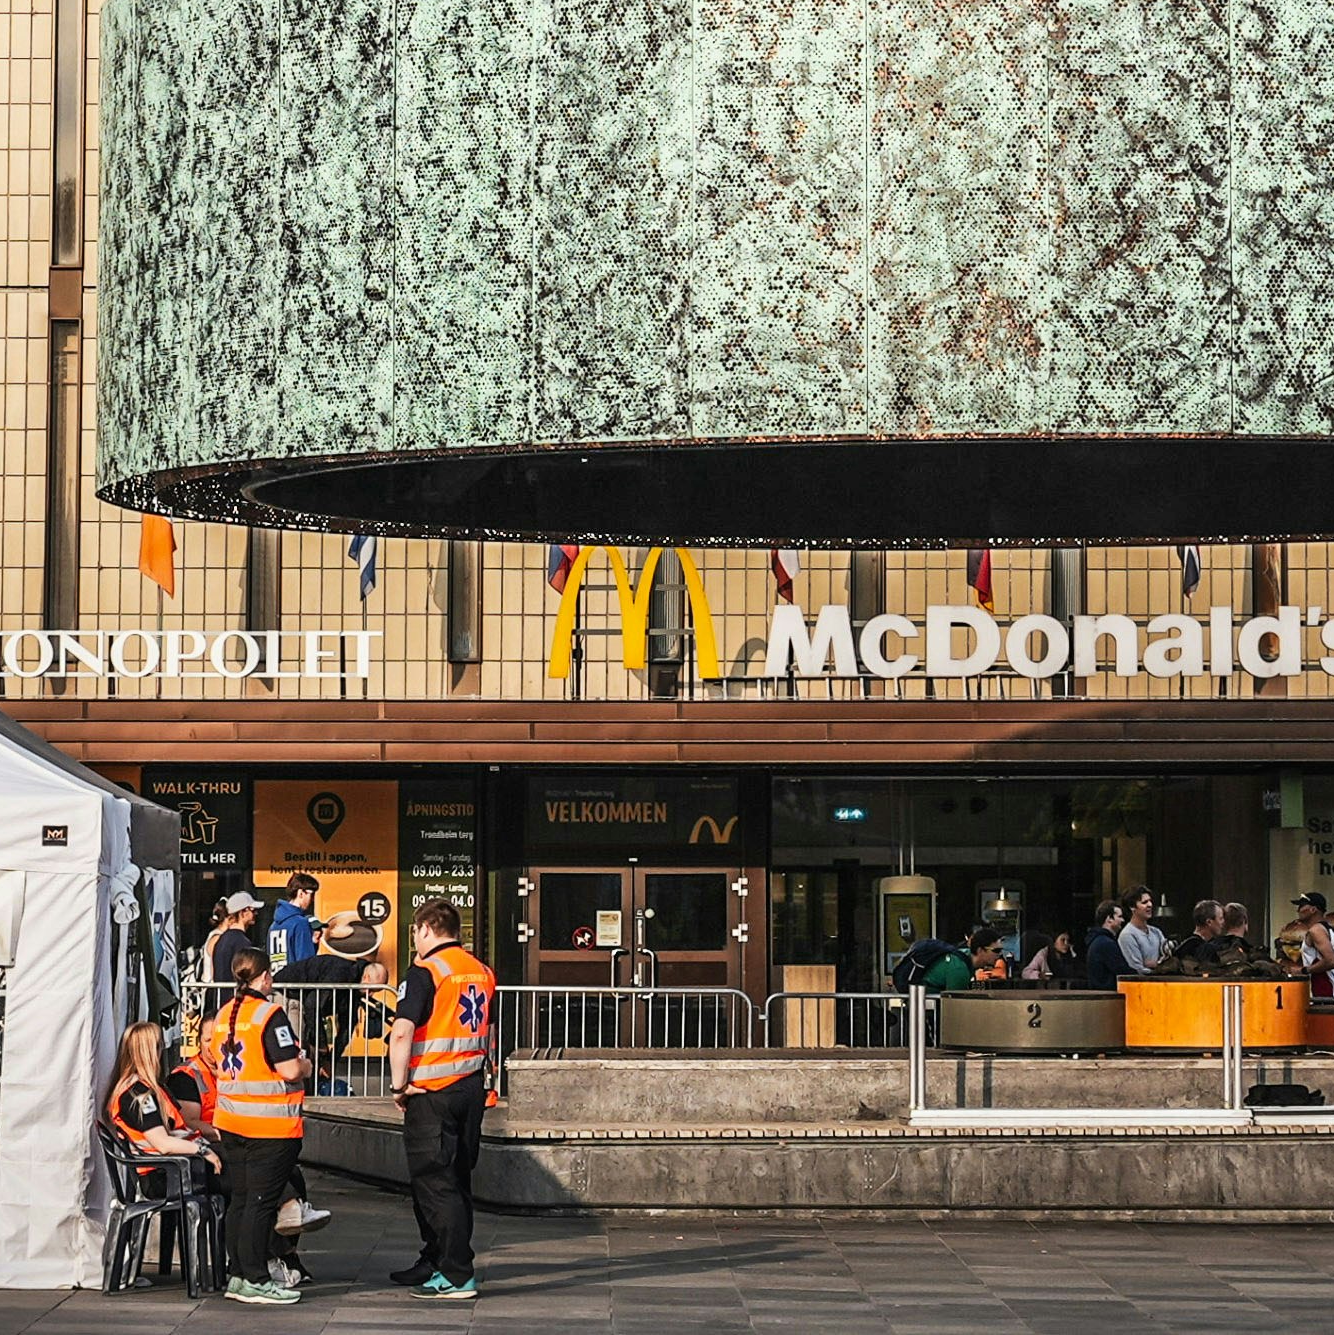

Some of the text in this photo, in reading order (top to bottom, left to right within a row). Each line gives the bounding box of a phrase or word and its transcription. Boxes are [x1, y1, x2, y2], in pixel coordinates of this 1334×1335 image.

[153, 782, 241, 794] WALK-THRU
[545, 801, 667, 823] VELKOMMEN
[180, 853, 236, 864] TILL HER
[284, 852, 321, 862] Bestill
[329, 853, 368, 864] appen,
[412, 865, 442, 877] 09.00
[1274, 986, 1284, 1009] 1
[1027, 1003, 1042, 1028] 2
